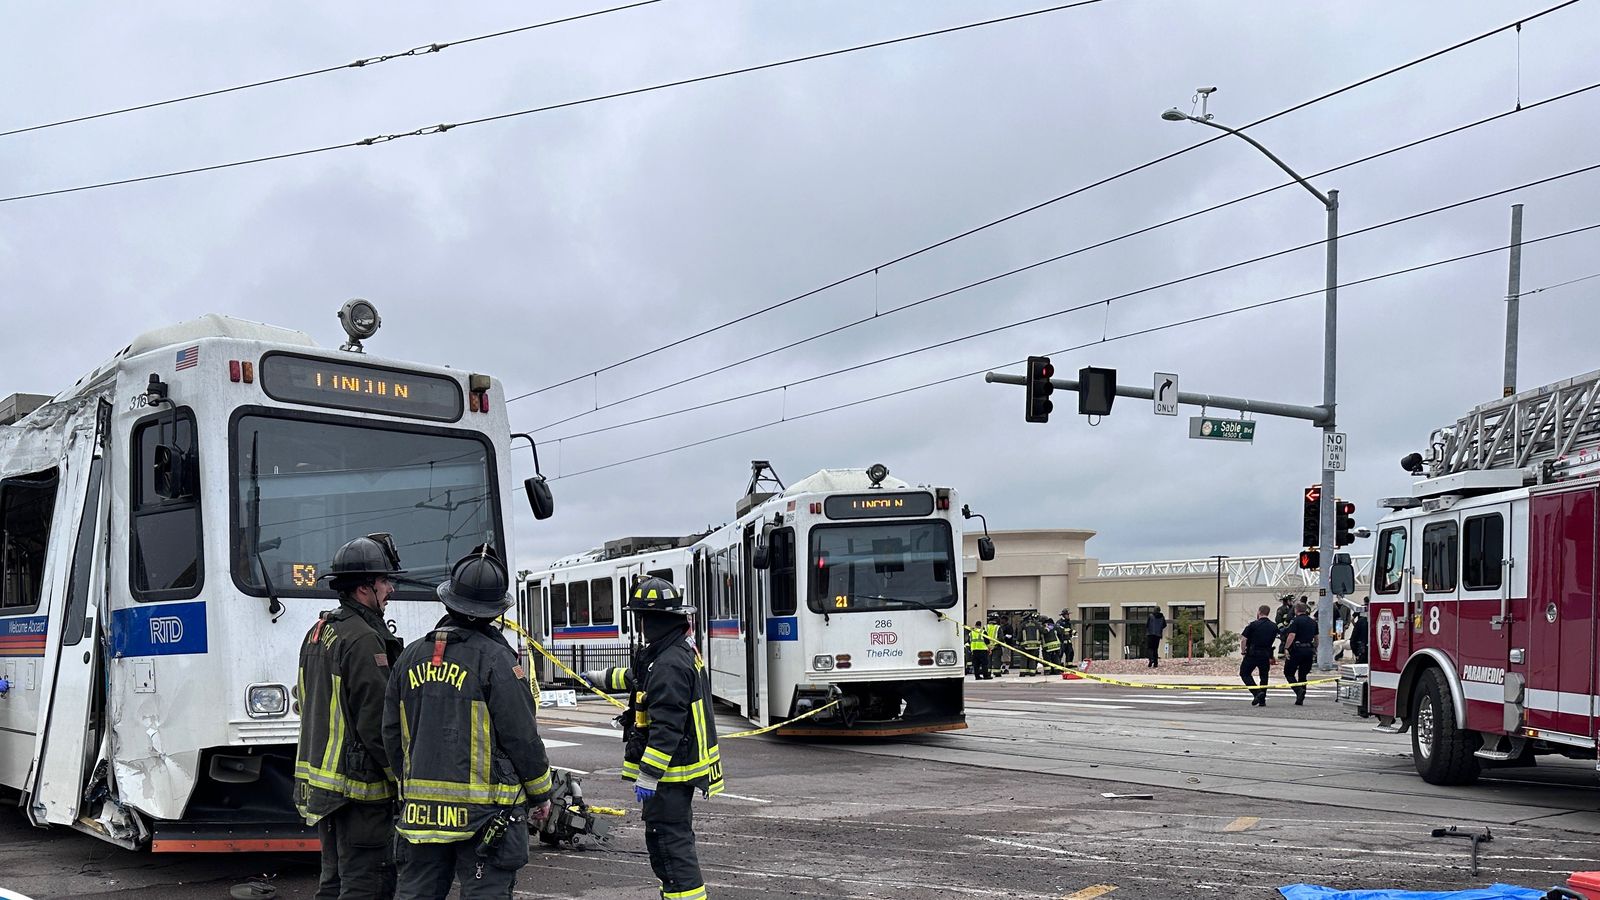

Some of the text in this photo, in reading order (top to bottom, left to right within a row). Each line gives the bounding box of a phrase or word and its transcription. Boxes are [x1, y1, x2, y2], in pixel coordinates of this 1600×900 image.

[1157, 403, 1175, 413] ONLY
[1220, 421, 1242, 433] Sable
[1327, 434, 1343, 445] NO
[1326, 444, 1343, 452] TURN
[1327, 460, 1341, 469] RED
[293, 564, 316, 587] 53
[835, 595, 848, 608] 21
[8, 620, 45, 633] Welcome Aboard
[874, 619, 893, 629] 286
[1429, 605, 1440, 635] 8
[149, 616, 184, 645] RTD
[778, 622, 791, 636] RTD
[870, 632, 898, 645] RTD
[408, 661, 468, 692] AURORA
[1462, 664, 1505, 684] PARAMEDIC
[402, 802, 468, 832] OGLUND
